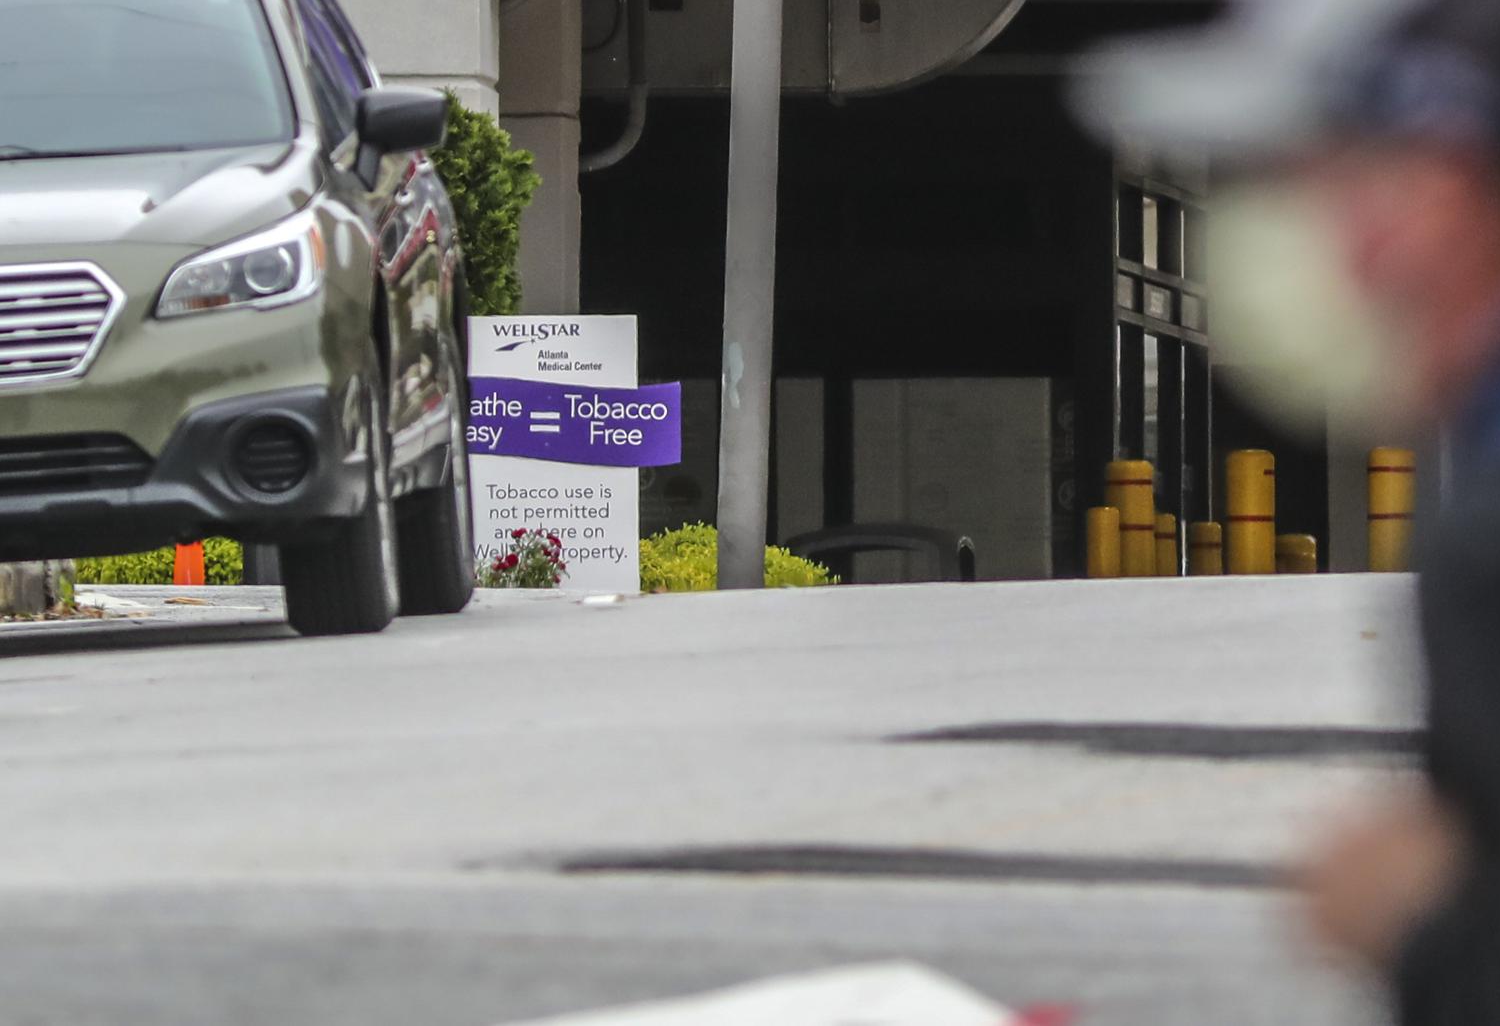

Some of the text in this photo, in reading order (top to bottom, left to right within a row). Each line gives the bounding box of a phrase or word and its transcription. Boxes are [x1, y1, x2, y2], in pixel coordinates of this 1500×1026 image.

[492, 323, 581, 341] WELLSTAR
[537, 349, 569, 360] Atlanta
[537, 361, 603, 372] Medical Center
[563, 393, 669, 421] Tobacco
[589, 420, 643, 446] Free
[486, 484, 612, 499] Tobacco use is
[489, 503, 610, 523] not permitted
[494, 523, 605, 539] anhere on
[474, 543, 628, 564] Well roperty.
